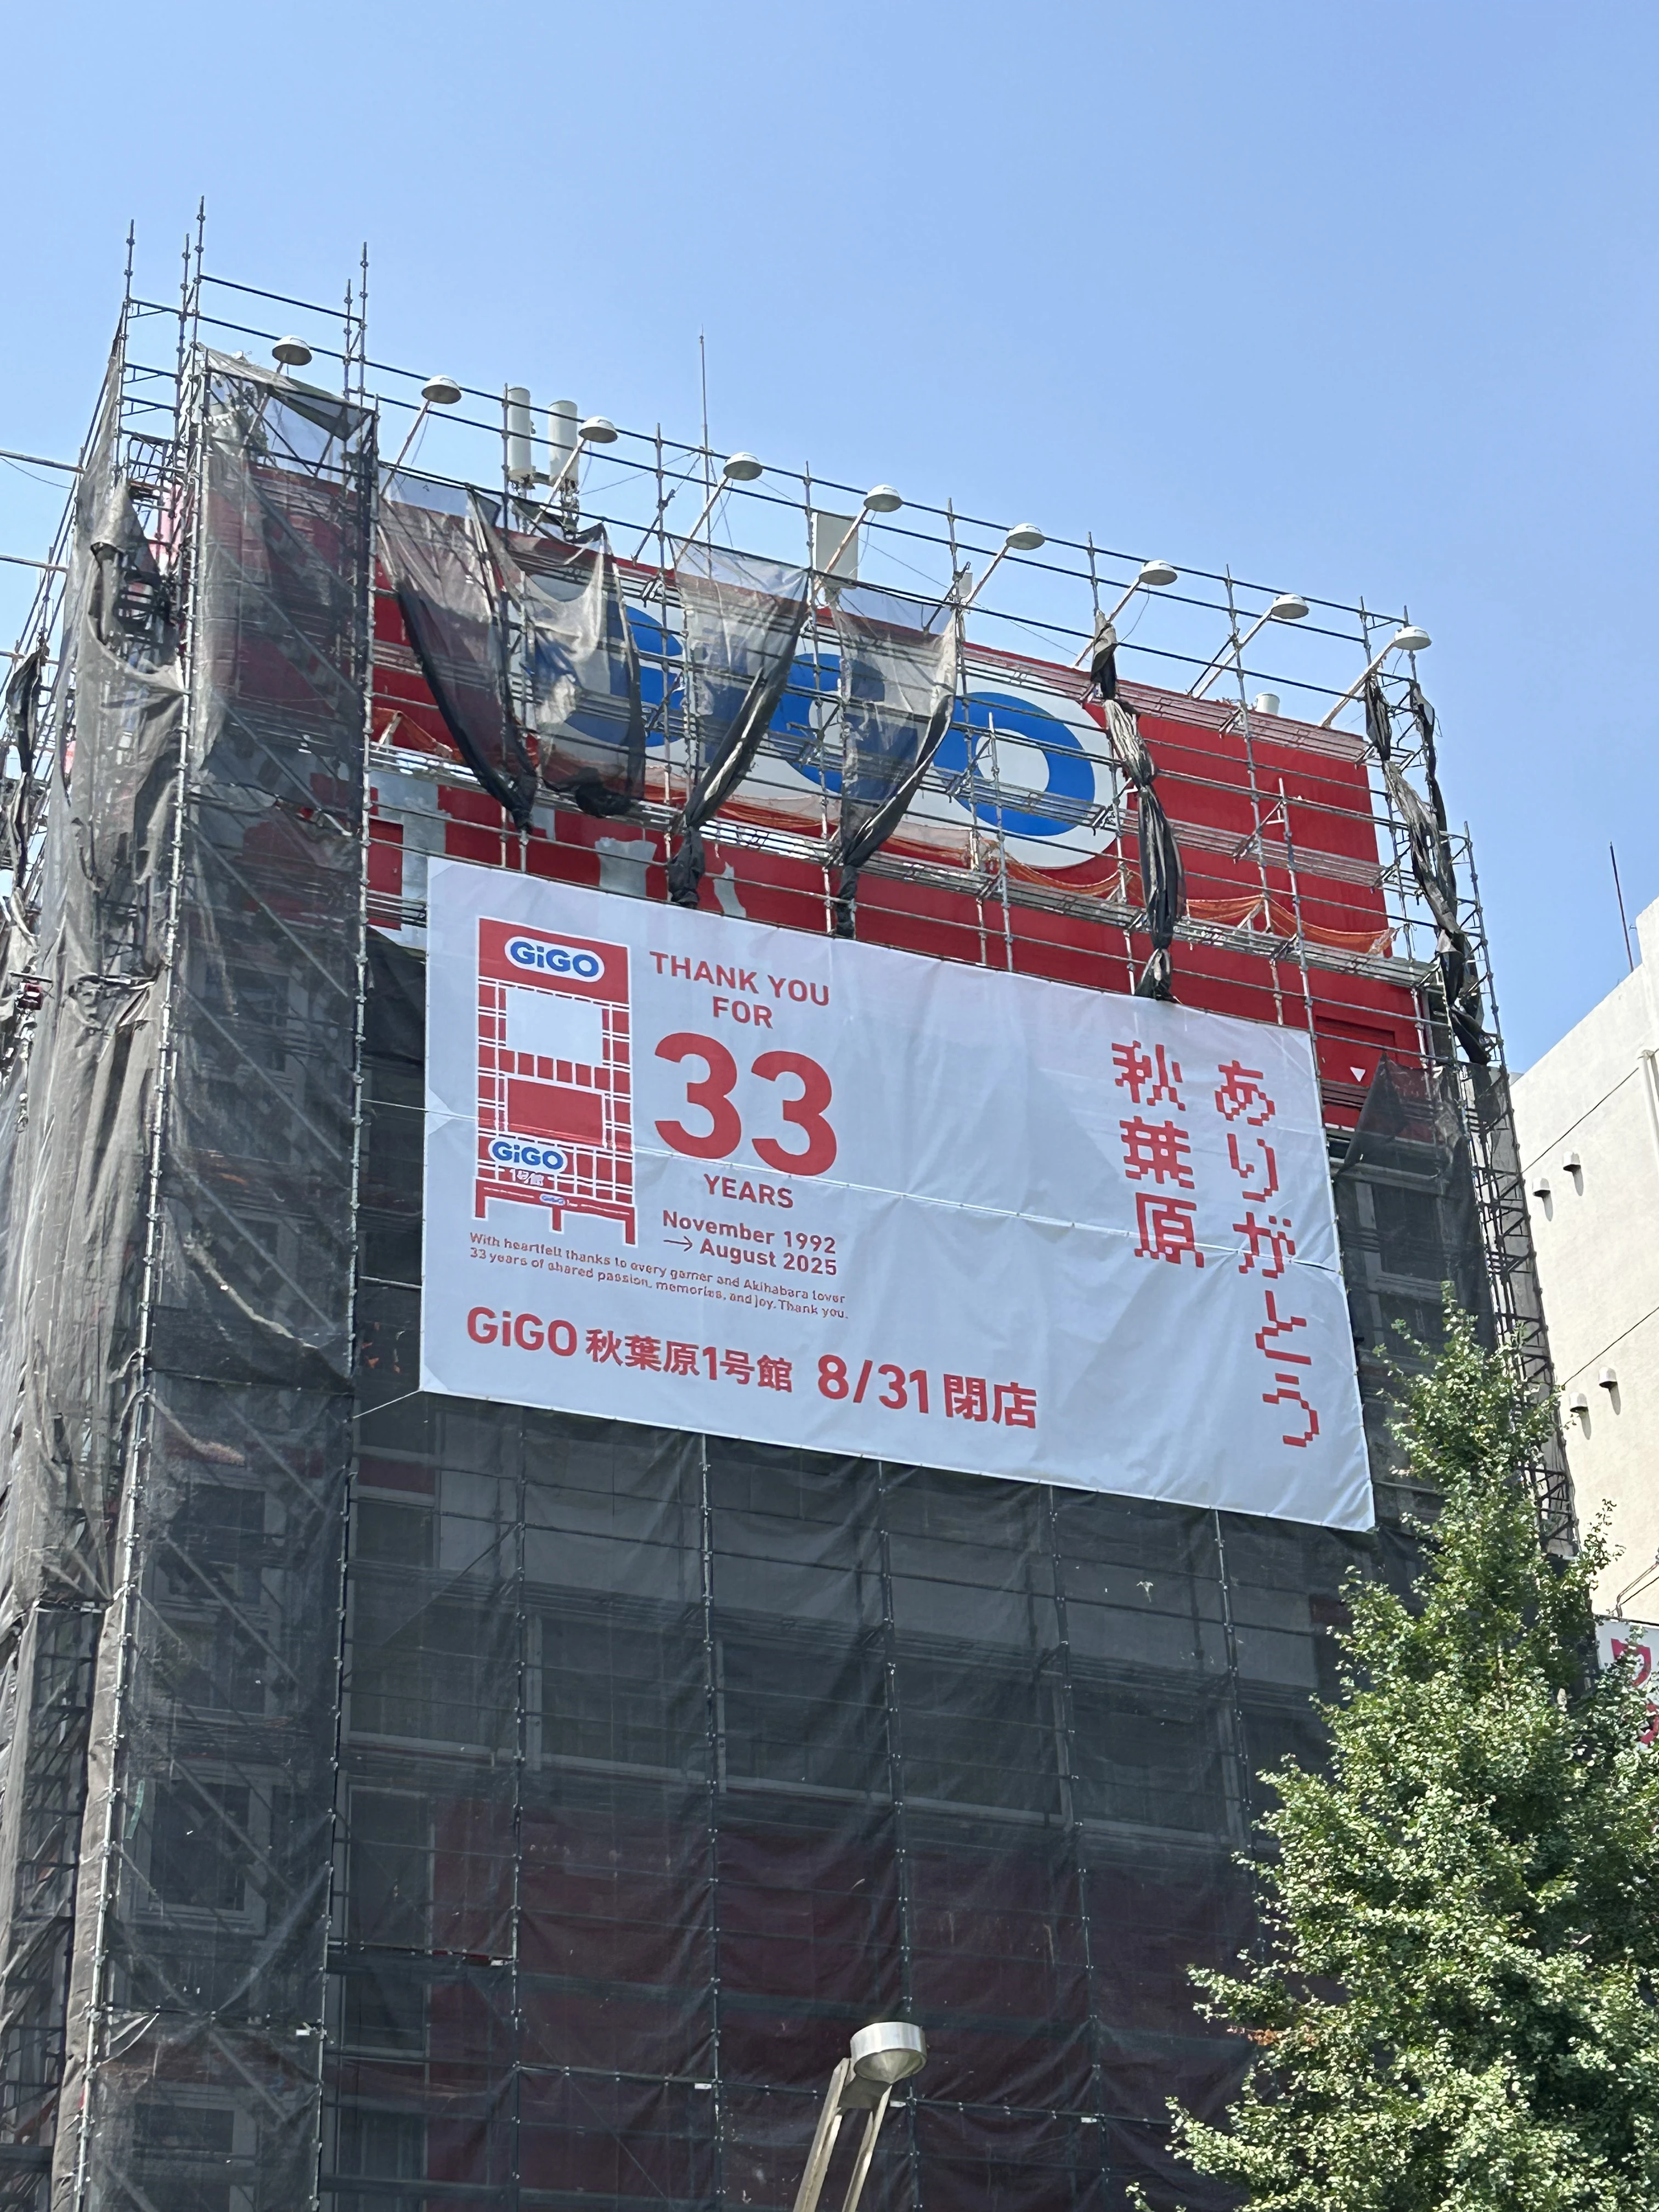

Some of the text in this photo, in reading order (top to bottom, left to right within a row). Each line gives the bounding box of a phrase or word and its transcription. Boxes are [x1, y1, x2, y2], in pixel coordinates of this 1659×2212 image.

[510, 941, 599, 978] GiGO
[650, 951, 830, 1006] THANK YOU
[713, 996, 774, 1029] FOR
[654, 1032, 837, 1176] 33
[492, 1141, 564, 1170] GiGO
[1111, 1040, 1204, 1268] 秋葉原
[703, 1173, 793, 1208] YEARS
[663, 1210, 836, 1254] November 1992
[700, 1238, 837, 1275] August 2025
[1215, 1060, 1319, 1448] ありがとう
[470, 1232, 500, 1248] With
[504, 1238, 562, 1257] heartfelt
[566, 1250, 610, 1265] thanks
[615, 1257, 627, 1268] to
[631, 1263, 667, 1277] every
[718, 1276, 739, 1287] and
[744, 1279, 808, 1299] Akihabara
[470, 1248, 486, 1259] 33
[490, 1252, 527, 1266] years
[531, 1259, 544, 1269] of
[548, 1262, 594, 1278] shared
[656, 1282, 726, 1301] memories,
[730, 1293, 752, 1304] and
[754, 1295, 776, 1310] joy.
[778, 1300, 818, 1314] Thank
[822, 1307, 848, 1318] you.
[467, 1306, 1036, 1429] GiGO 秋葉原1号館 8/31 閉店
